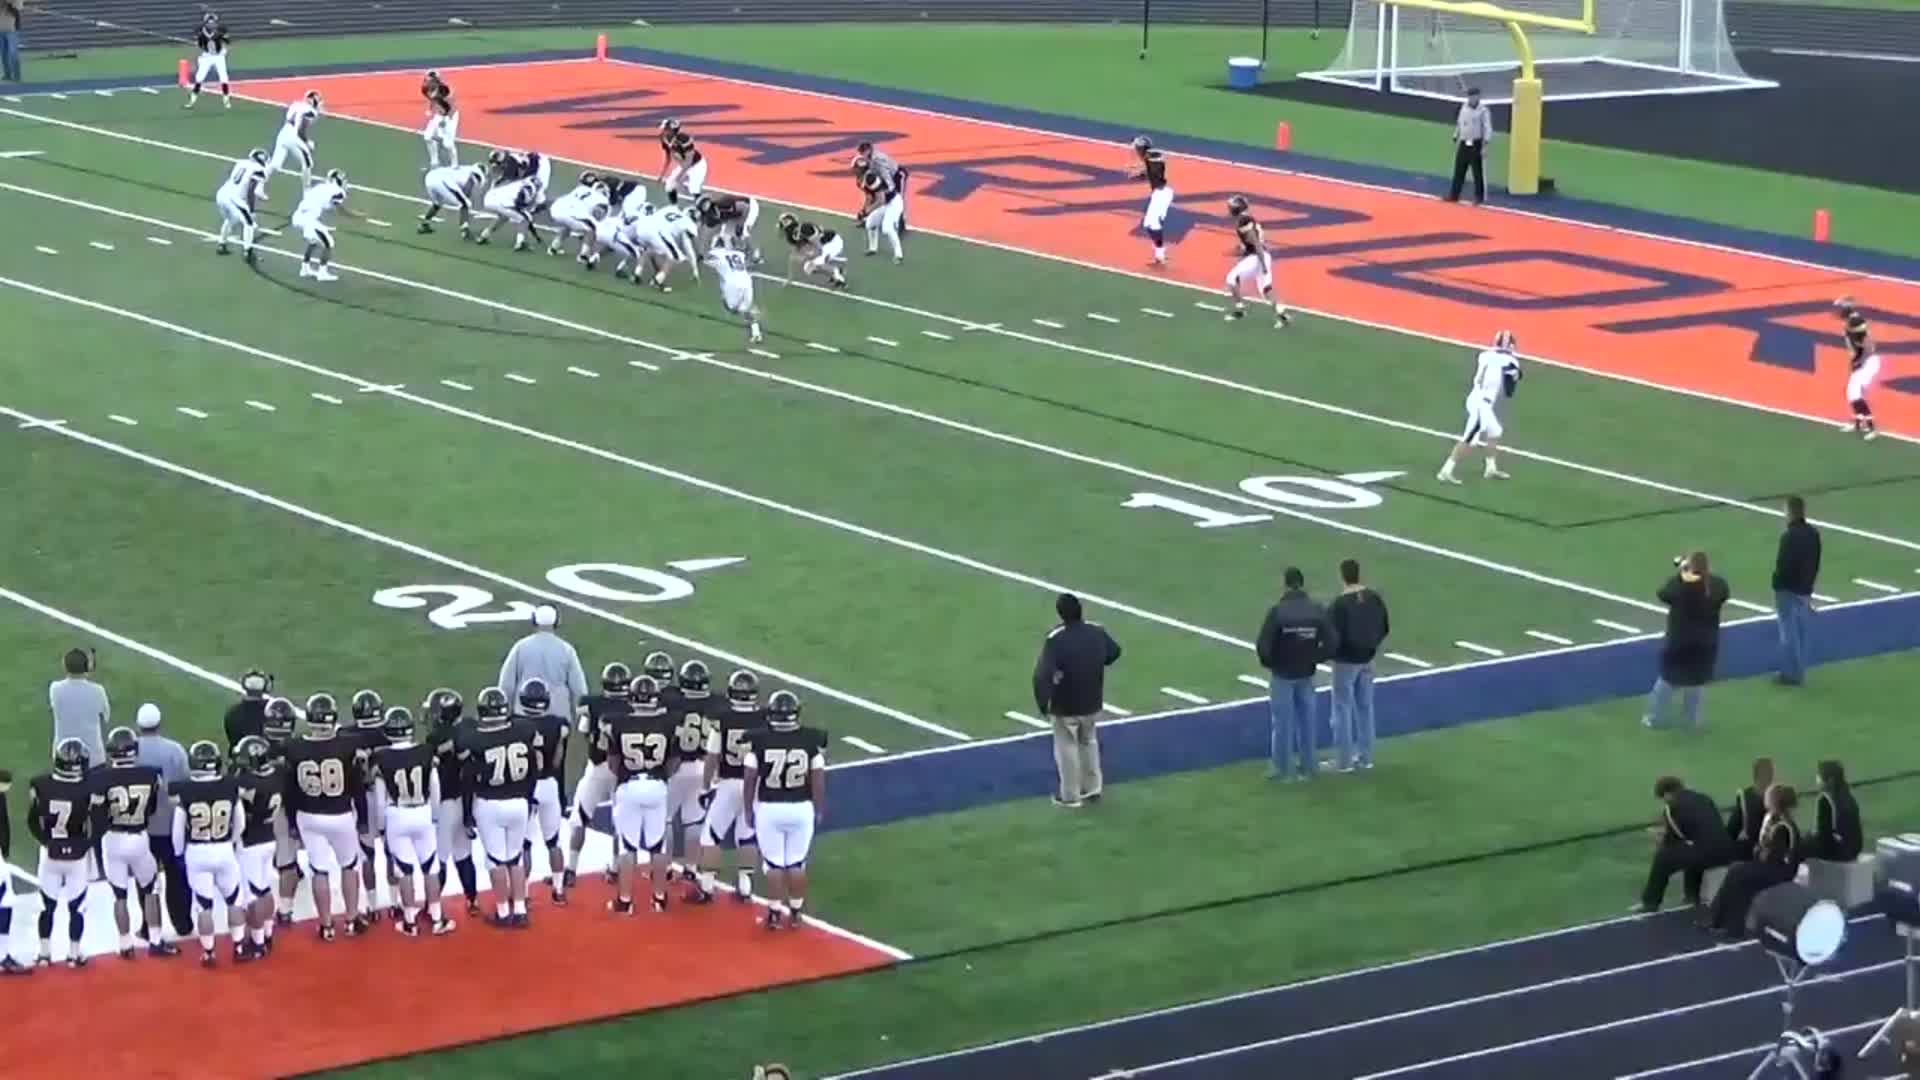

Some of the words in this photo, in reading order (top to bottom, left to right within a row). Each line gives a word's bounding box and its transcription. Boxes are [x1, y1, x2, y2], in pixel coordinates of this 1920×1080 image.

[484, 88, 1919, 395] WARRIOR
[1120, 476, 1383, 528] 10
[372, 563, 695, 629] 20
[485, 742, 529, 787] 76
[621, 733, 667, 771] 53
[765, 749, 809, 788] 72
[107, 784, 152, 825] 27
[394, 765, 425, 805] 11
[48, 799, 72, 839] 7
[189, 799, 232, 840] 28
